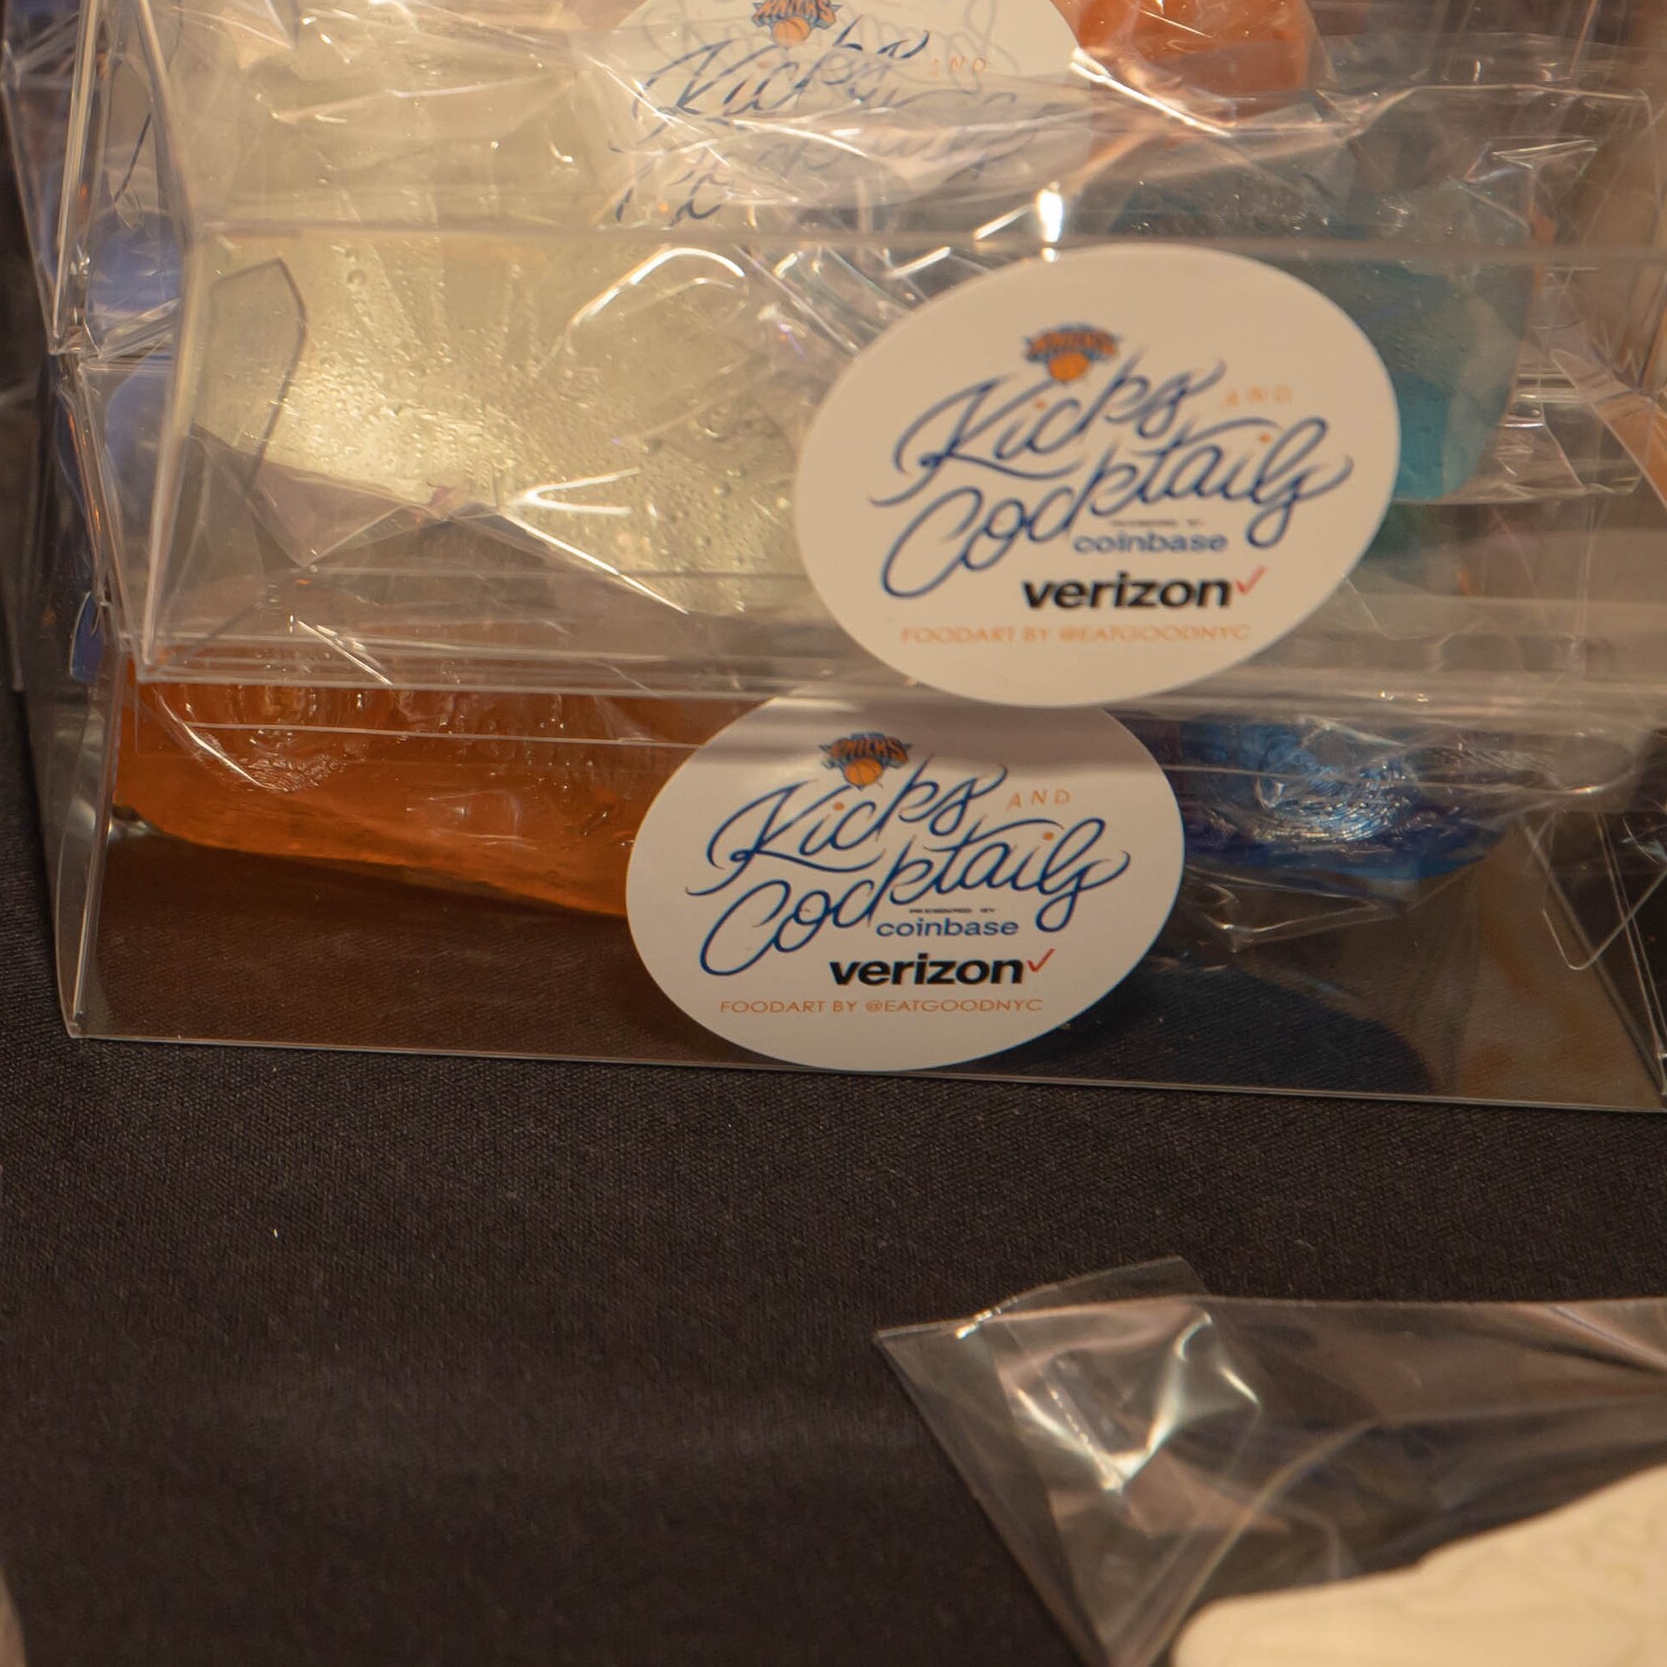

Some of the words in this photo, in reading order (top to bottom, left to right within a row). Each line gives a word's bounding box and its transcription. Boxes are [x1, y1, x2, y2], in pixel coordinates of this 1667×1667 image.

[869, 348, 1227, 507] Kicks
[881, 416, 1355, 599] Cocktails
[1073, 532, 1228, 554] coinbase
[1022, 570, 1233, 609] verizon
[686, 754, 1007, 896] Kicks
[1006, 789, 1071, 811] AND
[700, 818, 1130, 976] Cocktails
[876, 917, 1020, 937] coinbase
[829, 953, 1023, 986] verizon
[720, 1000, 825, 1014] FOODART
[832, 1000, 857, 1014] BY
[866, 998, 1043, 1013] @EATGOODNYC
